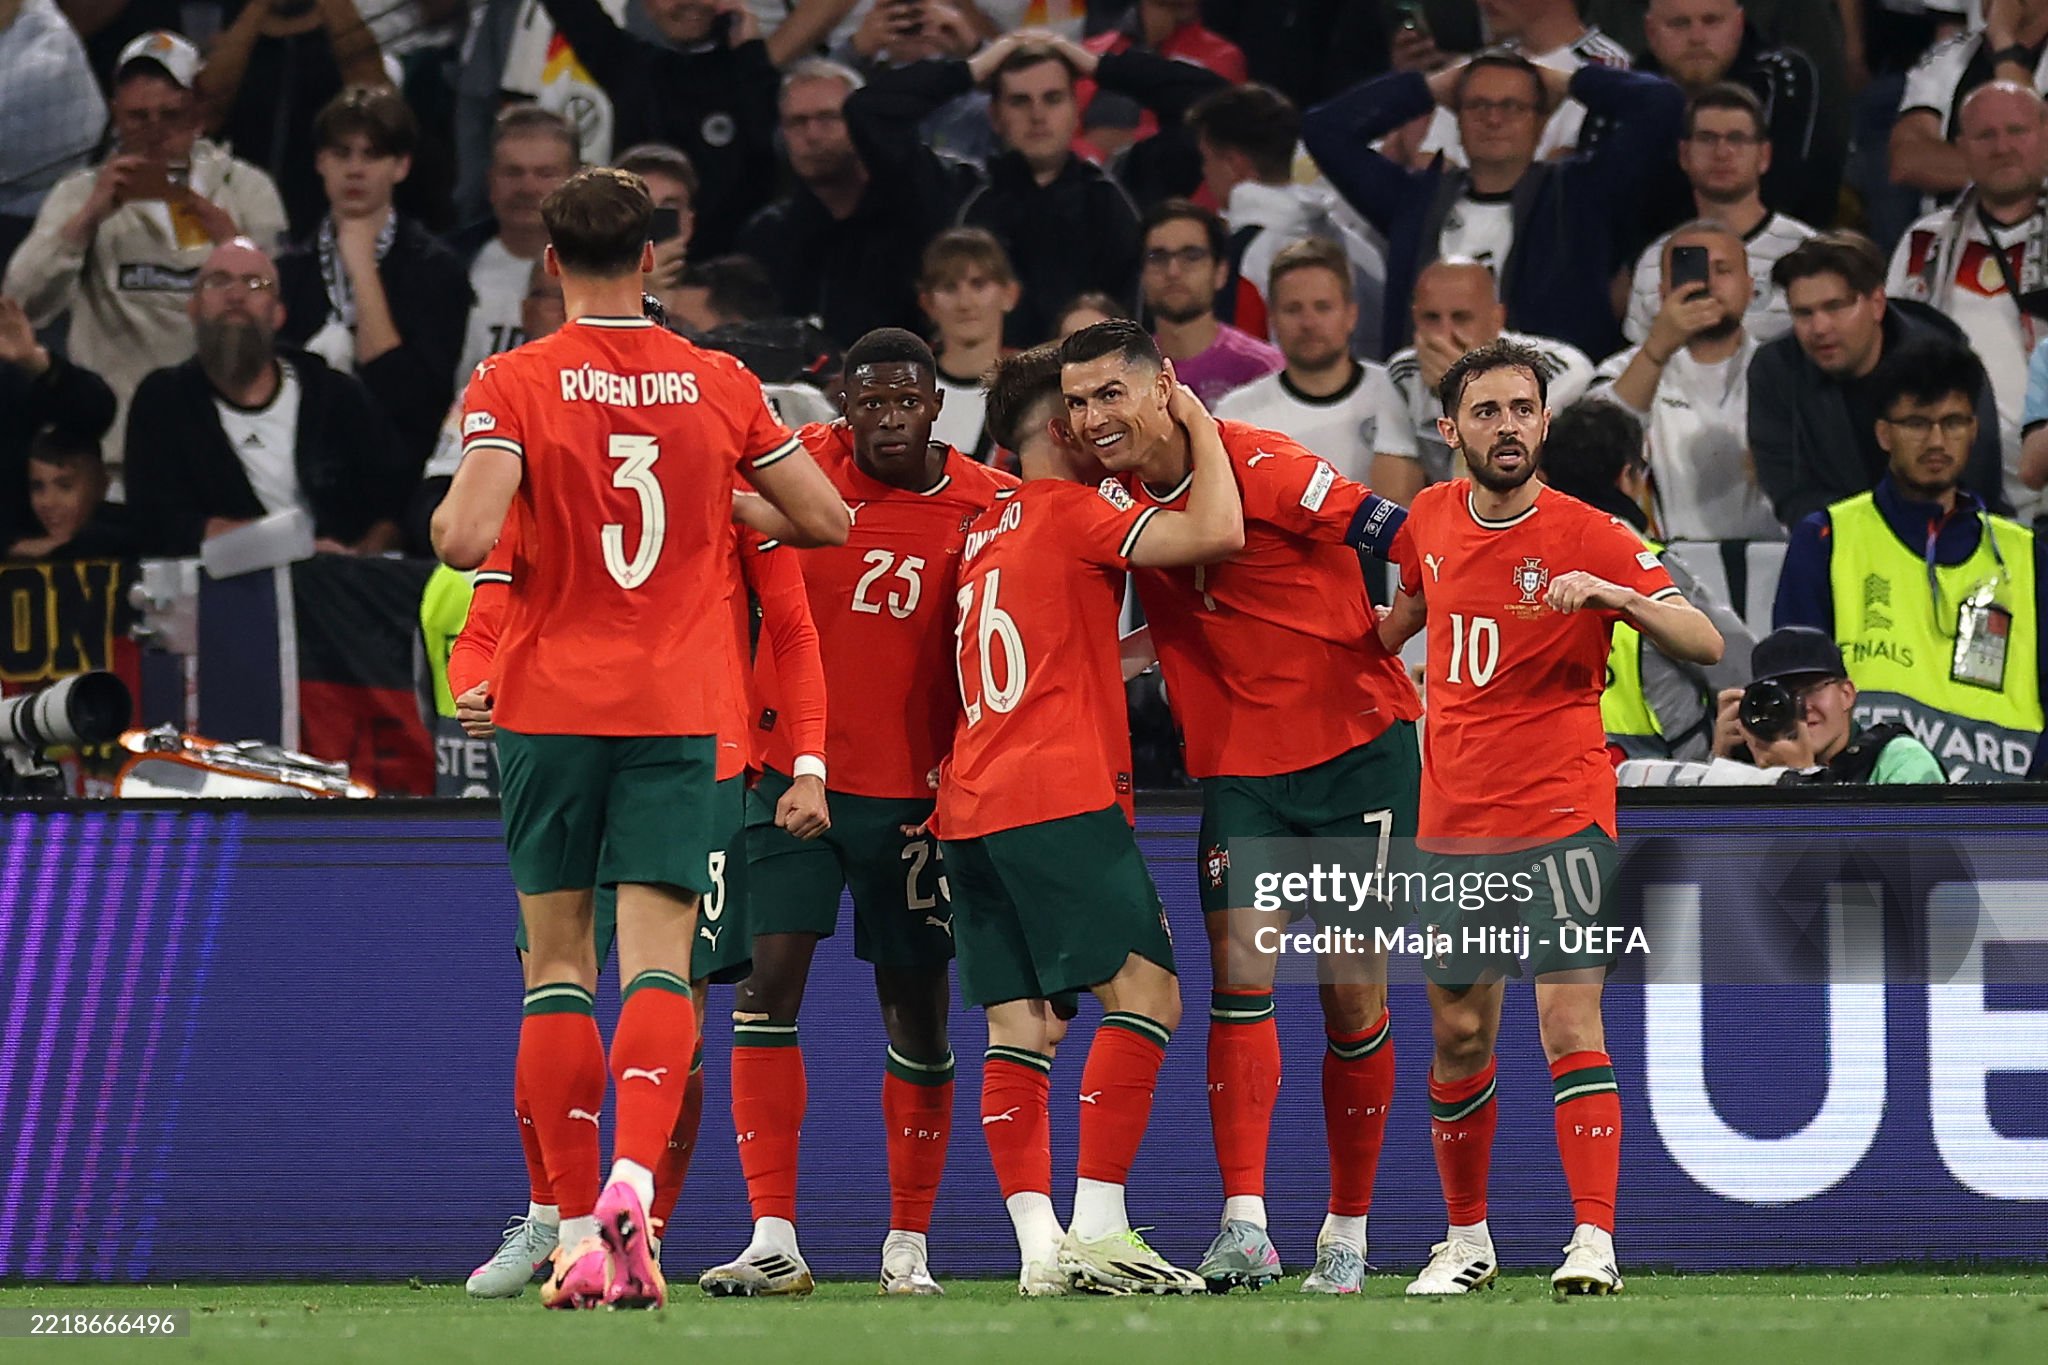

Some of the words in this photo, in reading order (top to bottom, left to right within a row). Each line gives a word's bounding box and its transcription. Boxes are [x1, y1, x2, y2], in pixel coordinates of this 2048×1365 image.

[560, 362, 637, 407] RÚBEN
[641, 372, 699, 406] DIAS
[601, 434, 665, 590] 3
[851, 549, 925, 619] 25
[1446, 613, 1499, 687] 10
[1838, 640, 1914, 668] FINALS
[436, 737, 502, 780] STE
[1363, 809, 1393, 880] 7
[1540, 847, 1601, 920] 10
